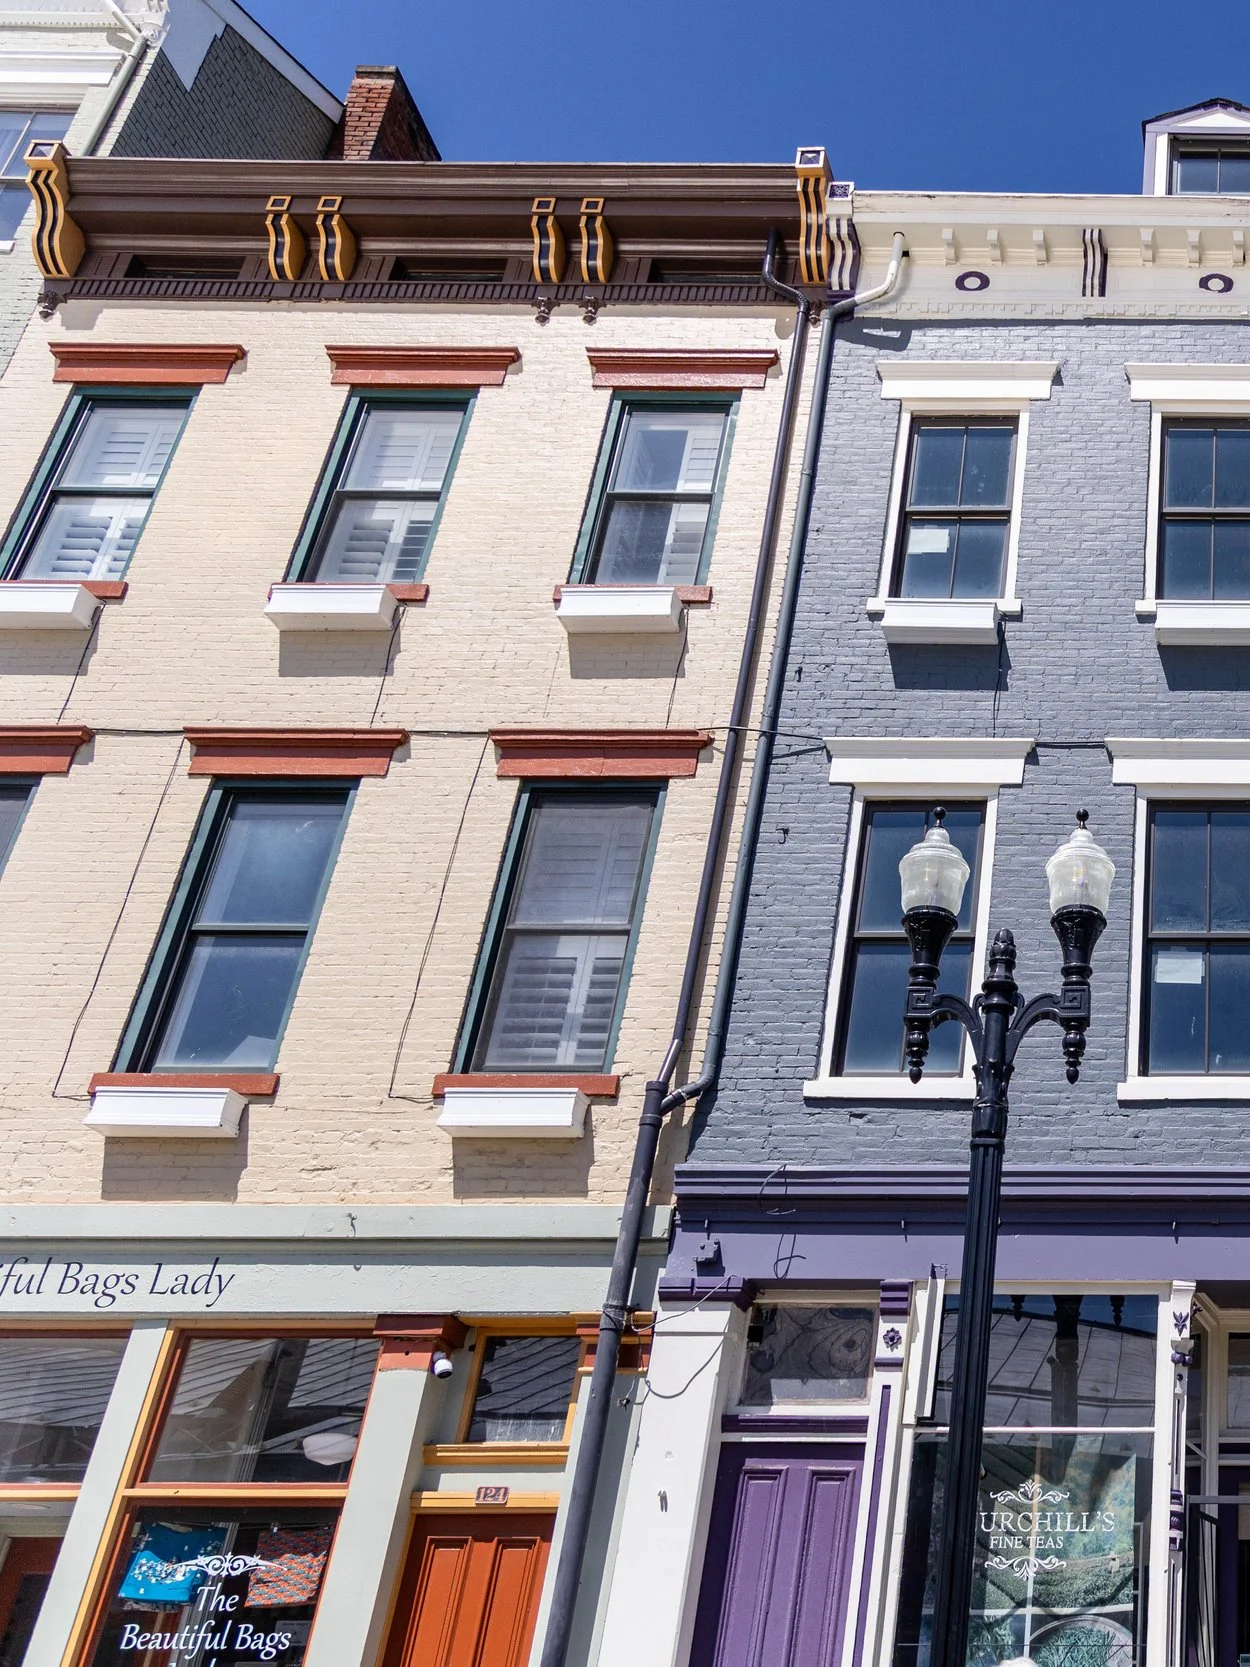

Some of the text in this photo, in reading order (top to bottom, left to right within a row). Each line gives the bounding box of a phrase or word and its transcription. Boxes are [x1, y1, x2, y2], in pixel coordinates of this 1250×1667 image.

[0, 1257, 235, 1308] ful Bags Lady
[479, 1487, 505, 1502] 124
[979, 1511, 1115, 1532] URCHILL'S
[989, 1536, 1064, 1549] FINE TEAS
[197, 1582, 240, 1612] The
[120, 1620, 292, 1660] Beautiful Bags
